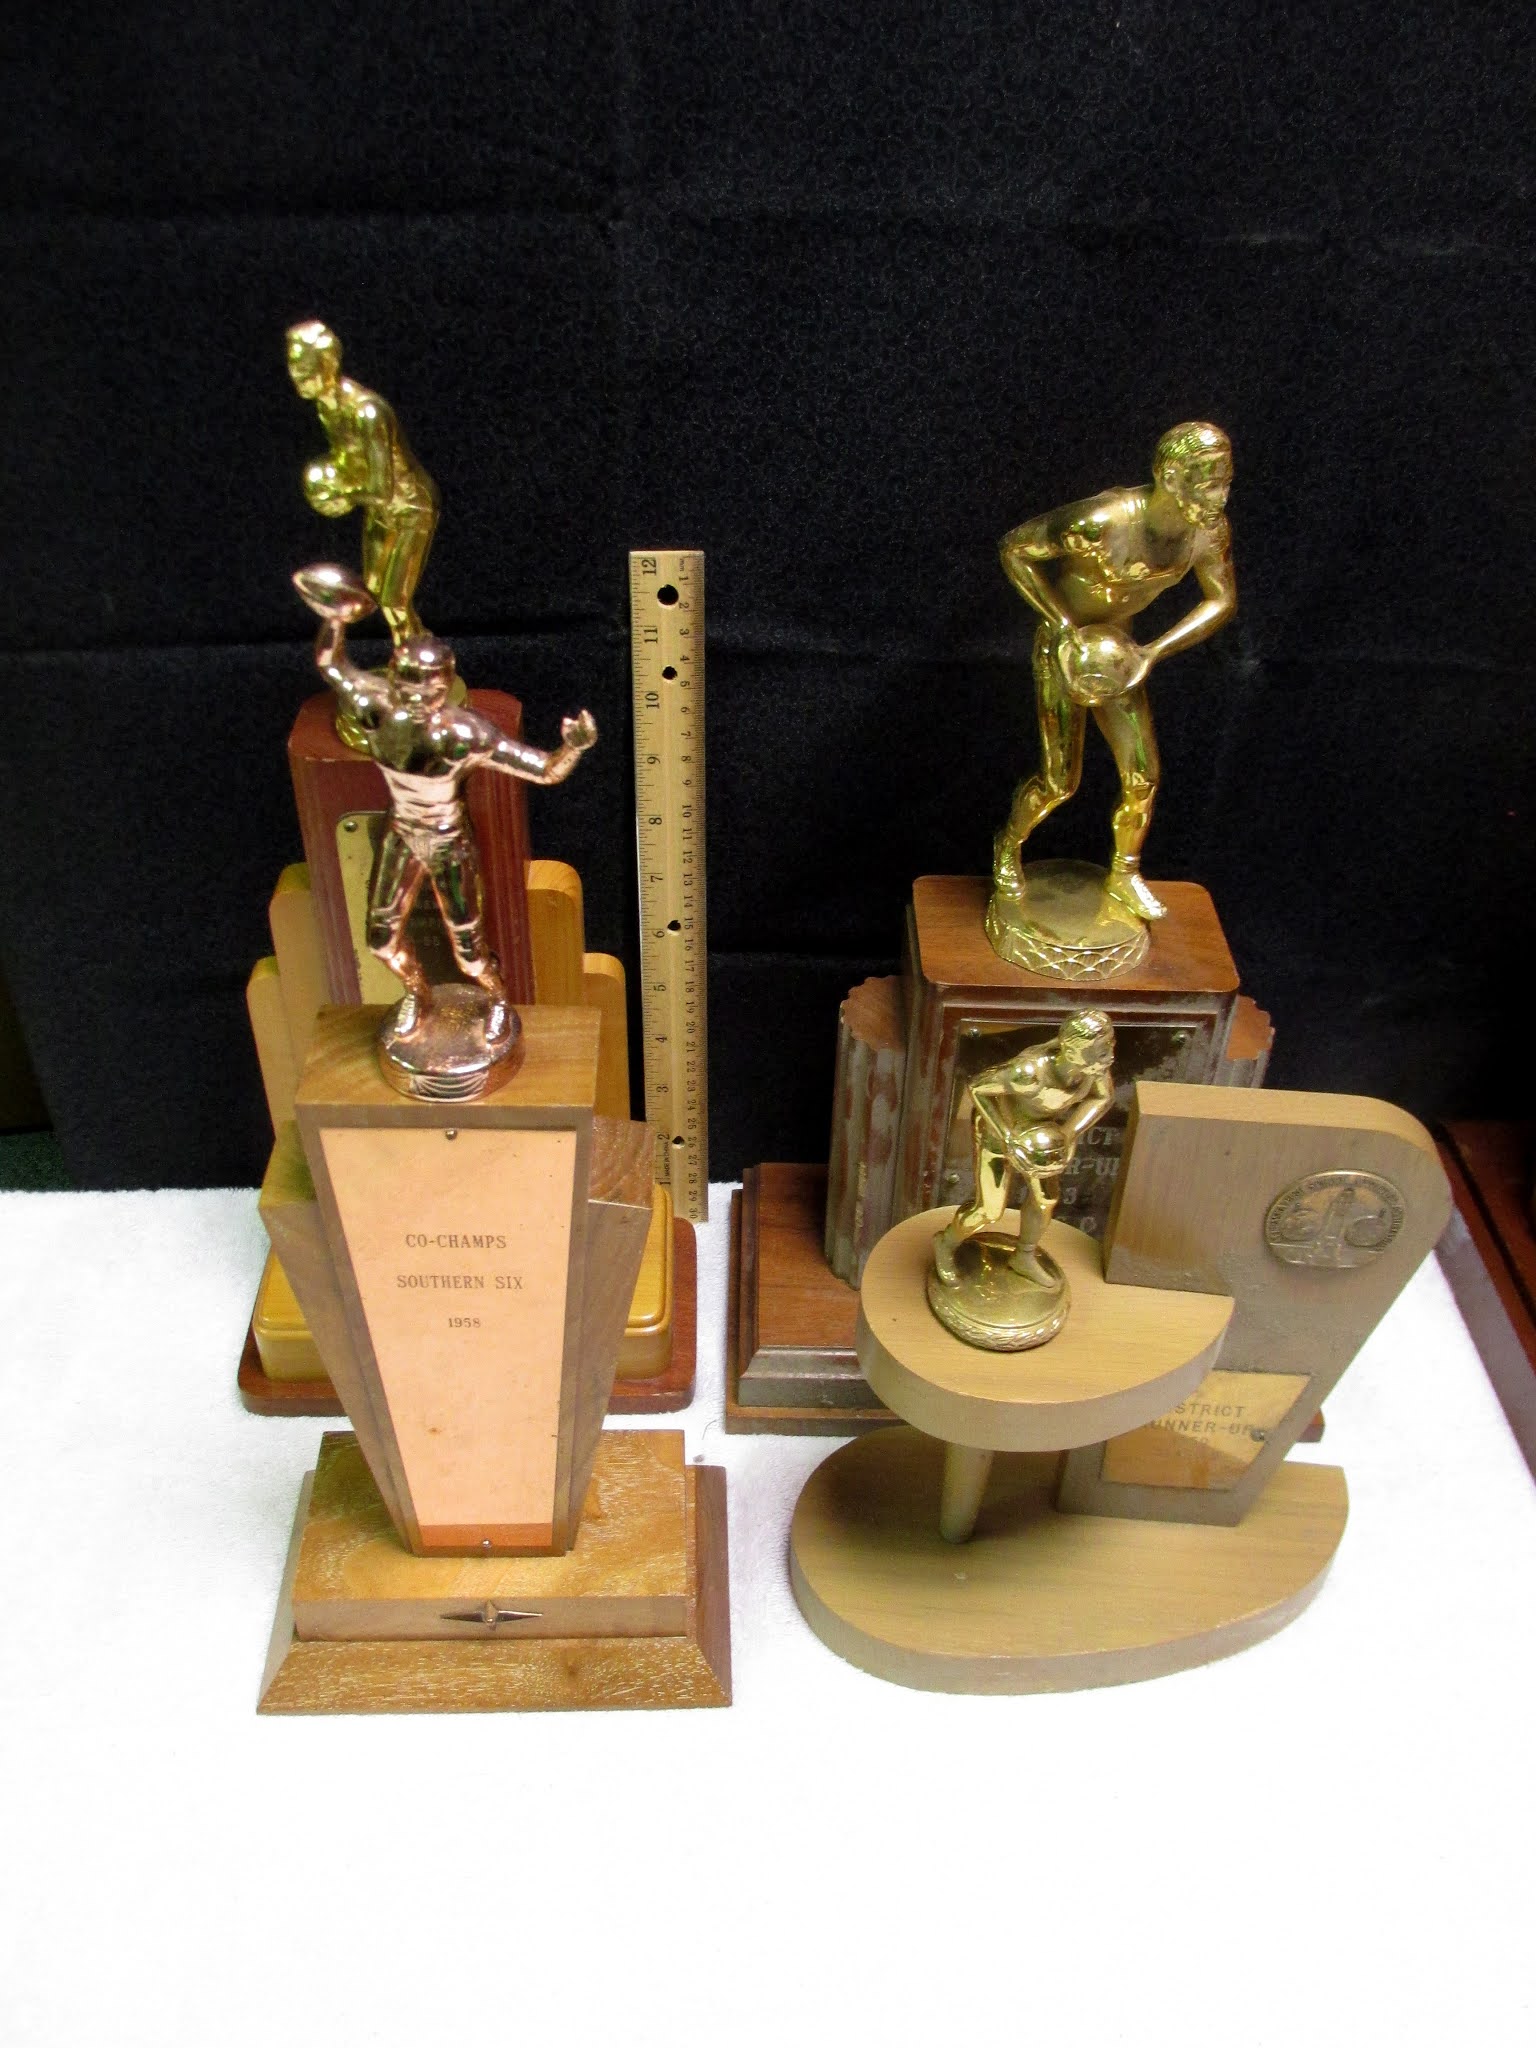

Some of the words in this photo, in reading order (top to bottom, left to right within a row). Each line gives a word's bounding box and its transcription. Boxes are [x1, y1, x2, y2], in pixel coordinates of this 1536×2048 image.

[642, 559, 656, 576] 12
[644, 628, 658, 644] 11
[680, 628, 689, 636] 3
[645, 692, 659, 709] 10
[647, 756, 660, 764] 9
[682, 804, 692, 818] 10
[648, 817, 662, 825] 8
[682, 828, 692, 840] 11
[683, 850, 693, 864] 12
[650, 875, 664, 883] 7
[683, 873, 693, 886] 13
[683, 895, 693, 908] 14
[684, 917, 694, 930] 15
[653, 930, 665, 939] 6
[684, 938, 694, 951] 16
[684, 960, 695, 972] 17
[653, 984, 667, 992] 5
[685, 981, 695, 993] 18
[685, 1001, 695, 1014] 19
[685, 1021, 696, 1034] 20
[686, 1041, 696, 1053] 21
[686, 1061, 696, 1073] 22
[686, 1080, 696, 1092] 23
[687, 1100, 697, 1111] 24
[687, 1118, 697, 1130] 25
[687, 1154, 698, 1166] 27
[689, 1207, 698, 1219] 30
[405, 1234, 507, 1249] CO-CHAMPS
[397, 1275, 485, 1289] SOUTHERN
[495, 1276, 524, 1290] SIX
[448, 1317, 481, 1328] 1958
[1174, 1402, 1246, 1418] STRICT
